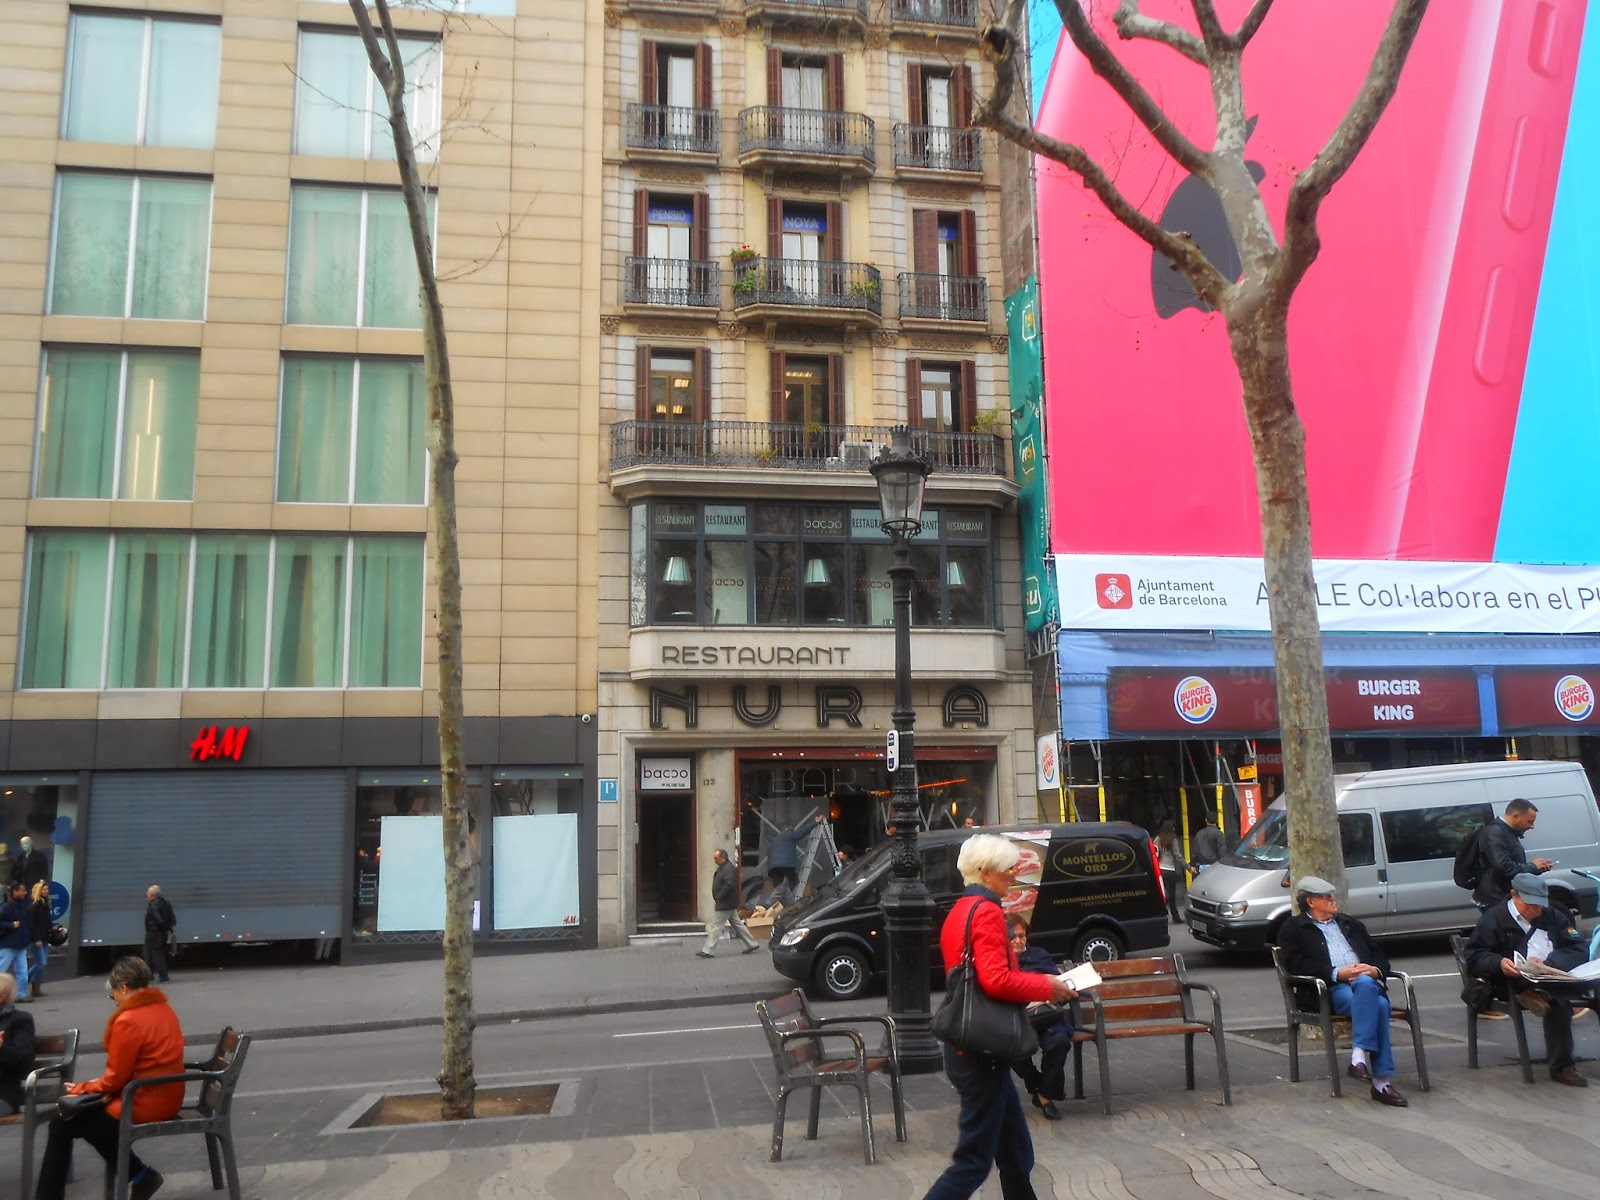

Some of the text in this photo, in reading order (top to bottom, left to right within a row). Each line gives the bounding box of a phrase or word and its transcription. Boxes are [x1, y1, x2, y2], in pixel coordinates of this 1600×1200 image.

[655, 514, 695, 525] RESTAURANT
[705, 515, 746, 525] RESTAURANT
[946, 521, 983, 532] RESTAURANT
[1137, 579, 1215, 593] Ajuntament
[1139, 594, 1227, 606] de Barcelona
[1256, 582, 1351, 606] ALE
[1508, 591, 1540, 609] en
[1548, 587, 1572, 610] el
[662, 646, 851, 665] RESTAURANT
[1180, 685, 1210, 702] BURGER
[1358, 680, 1421, 695] BURGER
[1560, 684, 1588, 700] BURGER
[1183, 692, 1212, 713] KING
[1563, 691, 1590, 710] KING
[1373, 704, 1414, 721] KING
[190, 724, 250, 761] H&M
[772, 767, 857, 792] BAR
[605, 782, 614, 794] P
[1062, 852, 1127, 866] MONTELLOS
[1084, 863, 1108, 873] ORO
